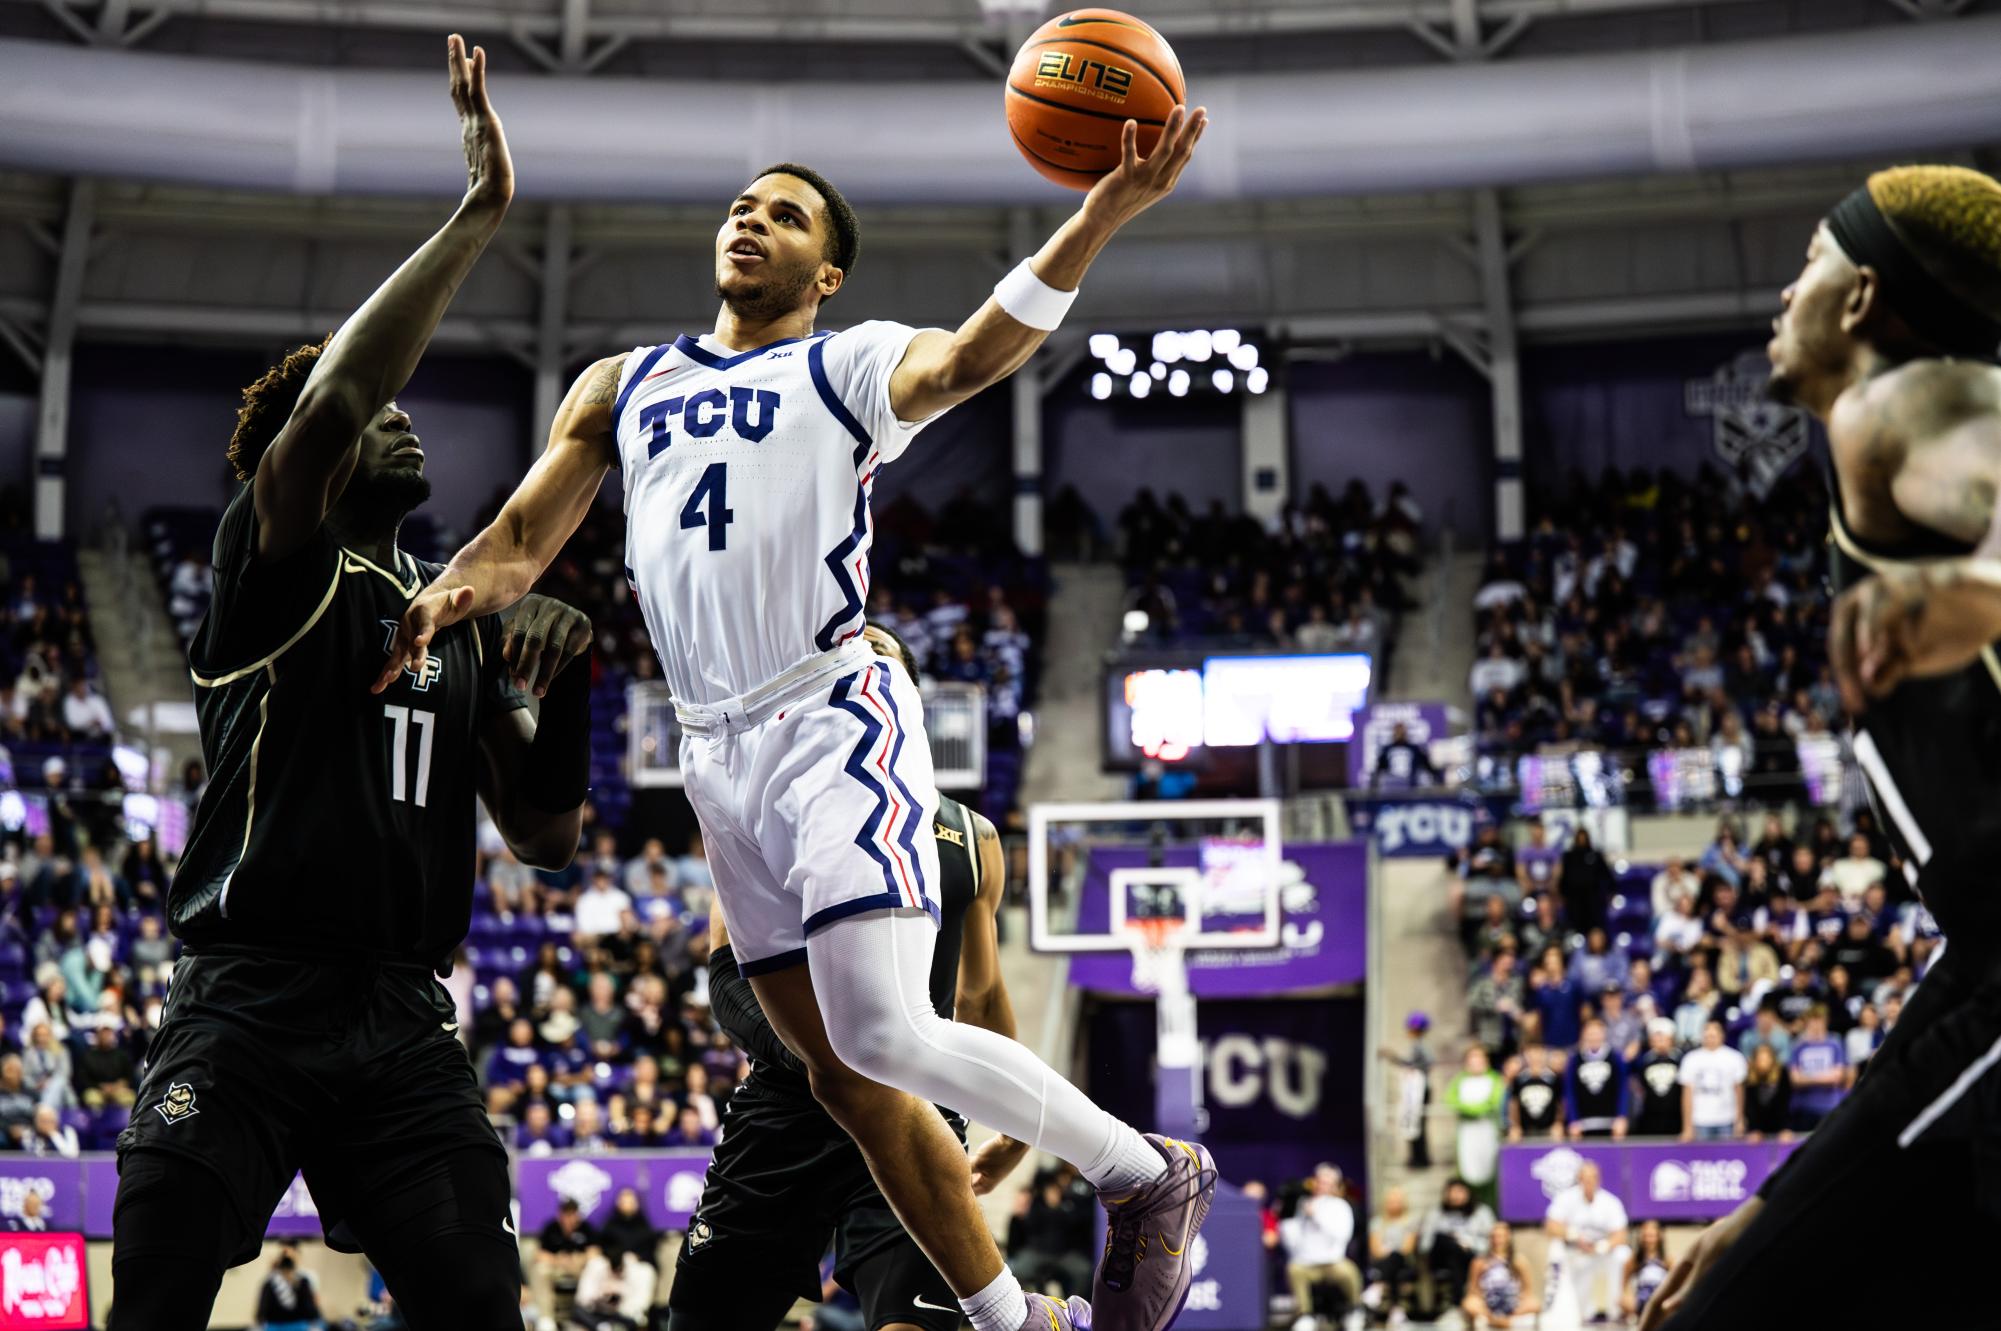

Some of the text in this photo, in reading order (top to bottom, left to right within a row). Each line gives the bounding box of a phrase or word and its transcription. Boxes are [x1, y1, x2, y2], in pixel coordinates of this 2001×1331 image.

[1034, 79, 1126, 105] CHAMPIONSHIP
[1036, 51, 1133, 97] ELITE
[639, 386, 781, 460] TCU
[680, 462, 734, 552] 4
[384, 704, 435, 808] 11
[1376, 805, 1474, 849] TCU
[1200, 1034, 1327, 1117] CU
